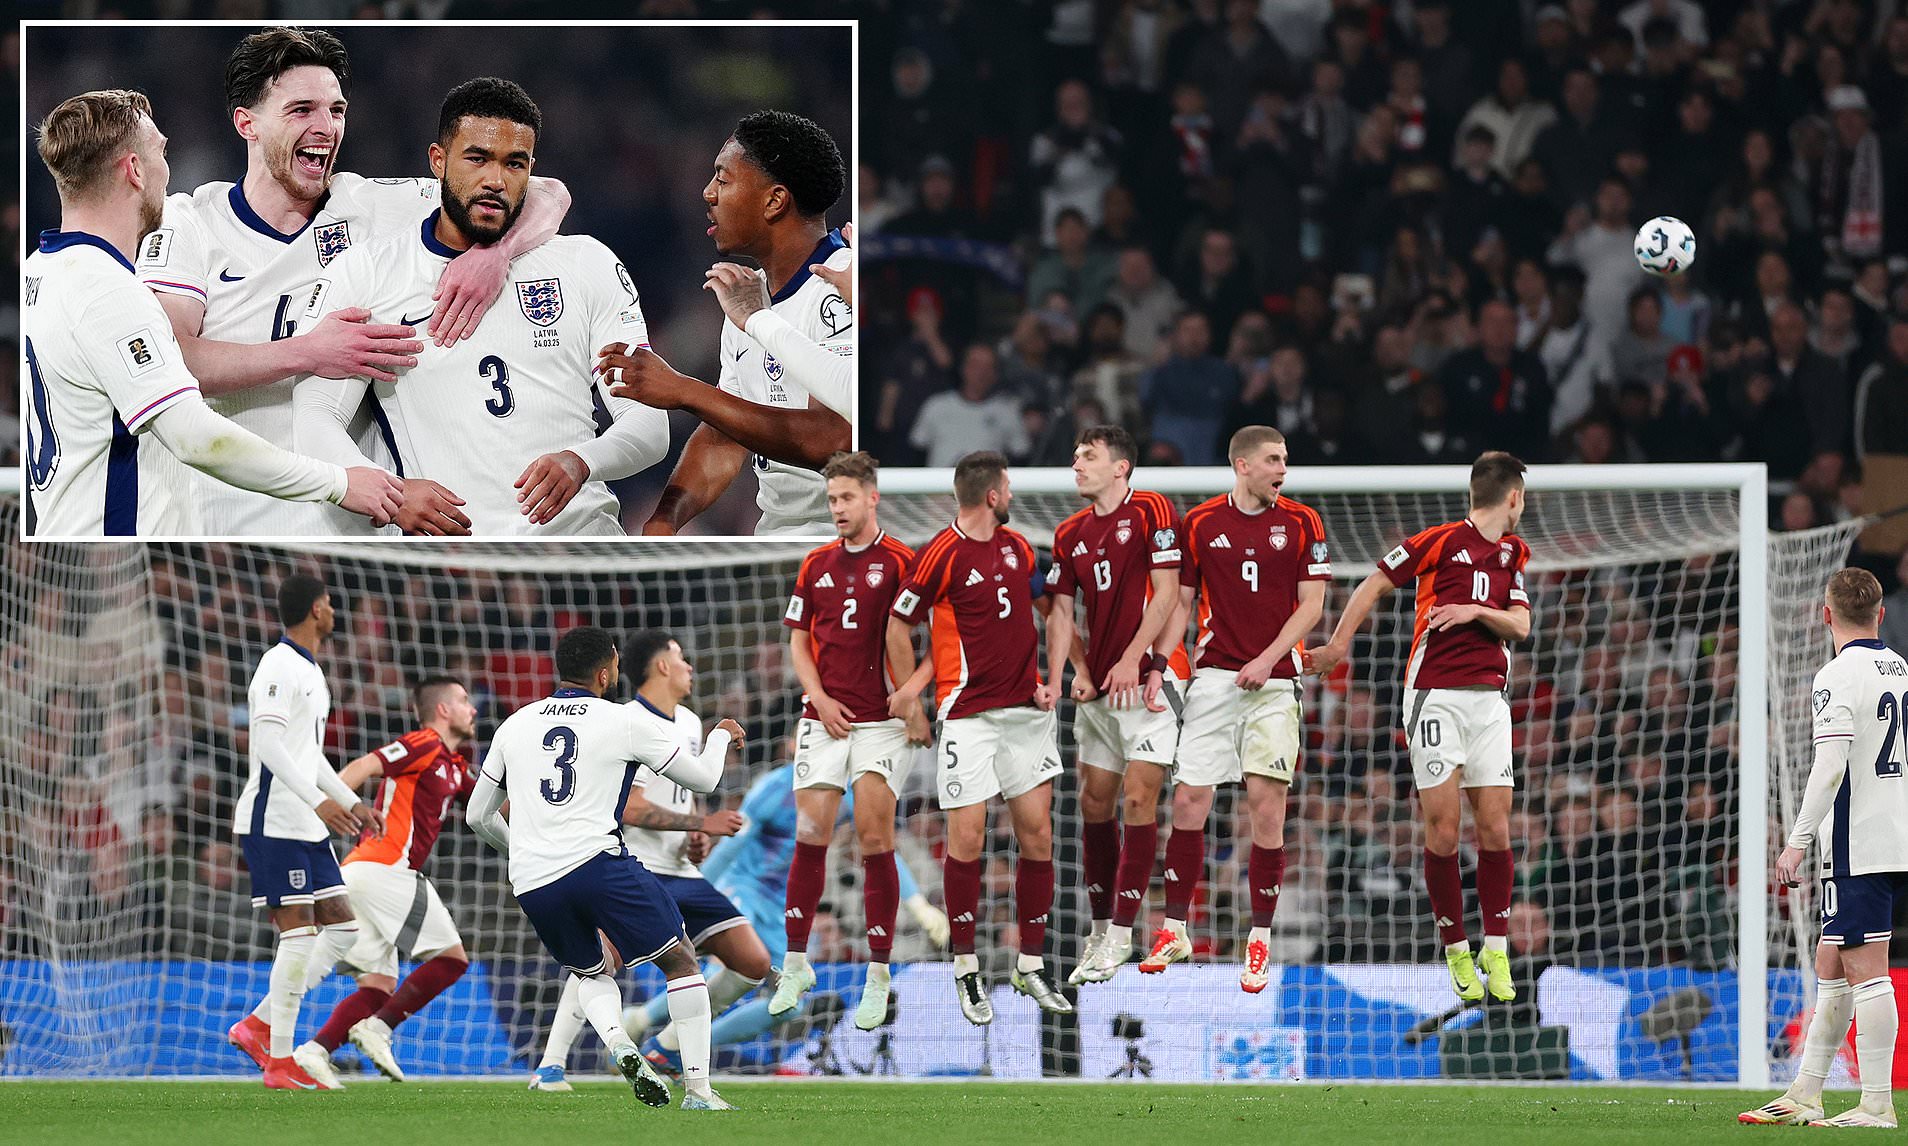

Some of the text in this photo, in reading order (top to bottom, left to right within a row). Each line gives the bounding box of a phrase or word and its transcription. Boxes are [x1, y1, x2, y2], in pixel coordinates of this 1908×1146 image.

[534, 329, 558, 338] LATVIA
[534, 339, 560, 348] 24.03.25
[479, 355, 515, 418] 3
[1093, 560, 1112, 591] 13
[1242, 561, 1258, 592] 9
[1472, 570, 1490, 602] 10
[842, 598, 858, 629] 2
[997, 587, 1012, 619] 5
[1874, 660, 1908, 676] BOWEN
[539, 704, 588, 716] JAMES
[800, 722, 811, 749] 2
[1420, 719, 1441, 748] 10
[540, 726, 578, 806] 3
[946, 741, 958, 769] 5
